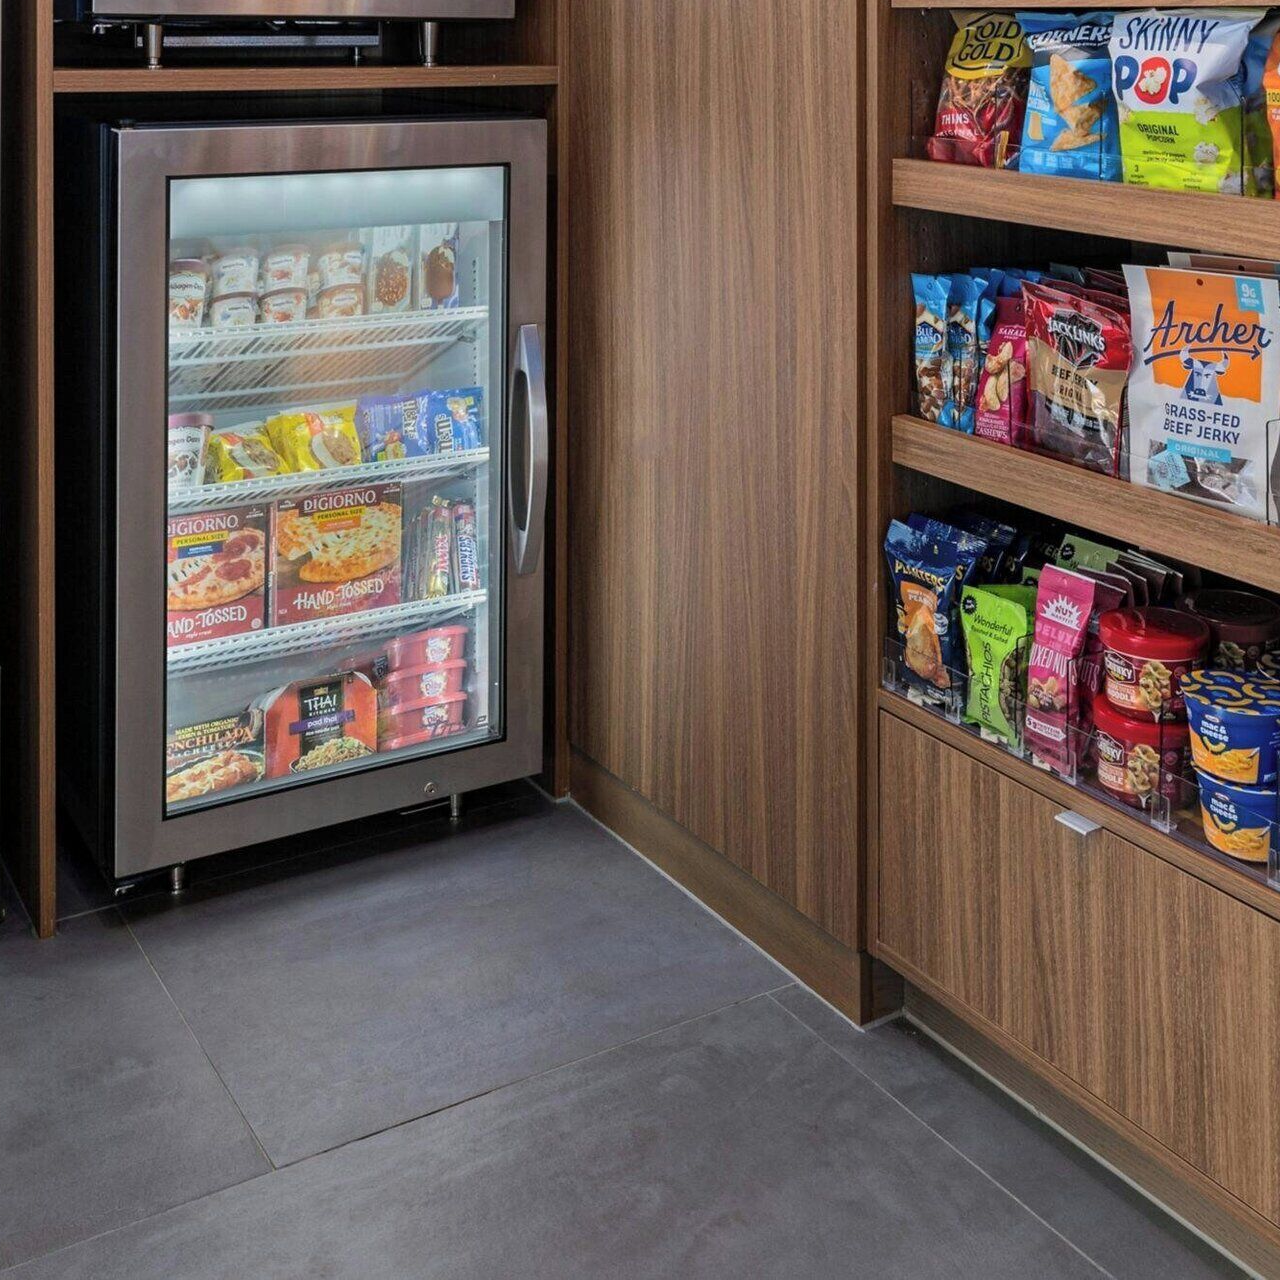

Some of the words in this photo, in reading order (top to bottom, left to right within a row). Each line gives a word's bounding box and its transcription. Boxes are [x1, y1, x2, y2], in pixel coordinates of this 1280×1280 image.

[957, 42, 1016, 65] GOLD
[941, 112, 970, 126] THINS
[1137, 122, 1180, 137] ORIGINAL
[1046, 317, 1074, 341] JACK
[1140, 299, 1272, 354] Archer
[1163, 402, 1241, 428] GRASS-FED
[1163, 418, 1193, 436] BEEF
[1196, 426, 1241, 446] JERKY
[1174, 442, 1222, 460] ORIGINAL
[1055, 604, 1073, 618] NUT
[972, 614, 1013, 635] Wonderful
[980, 640, 992, 724] PISTACHIOS
